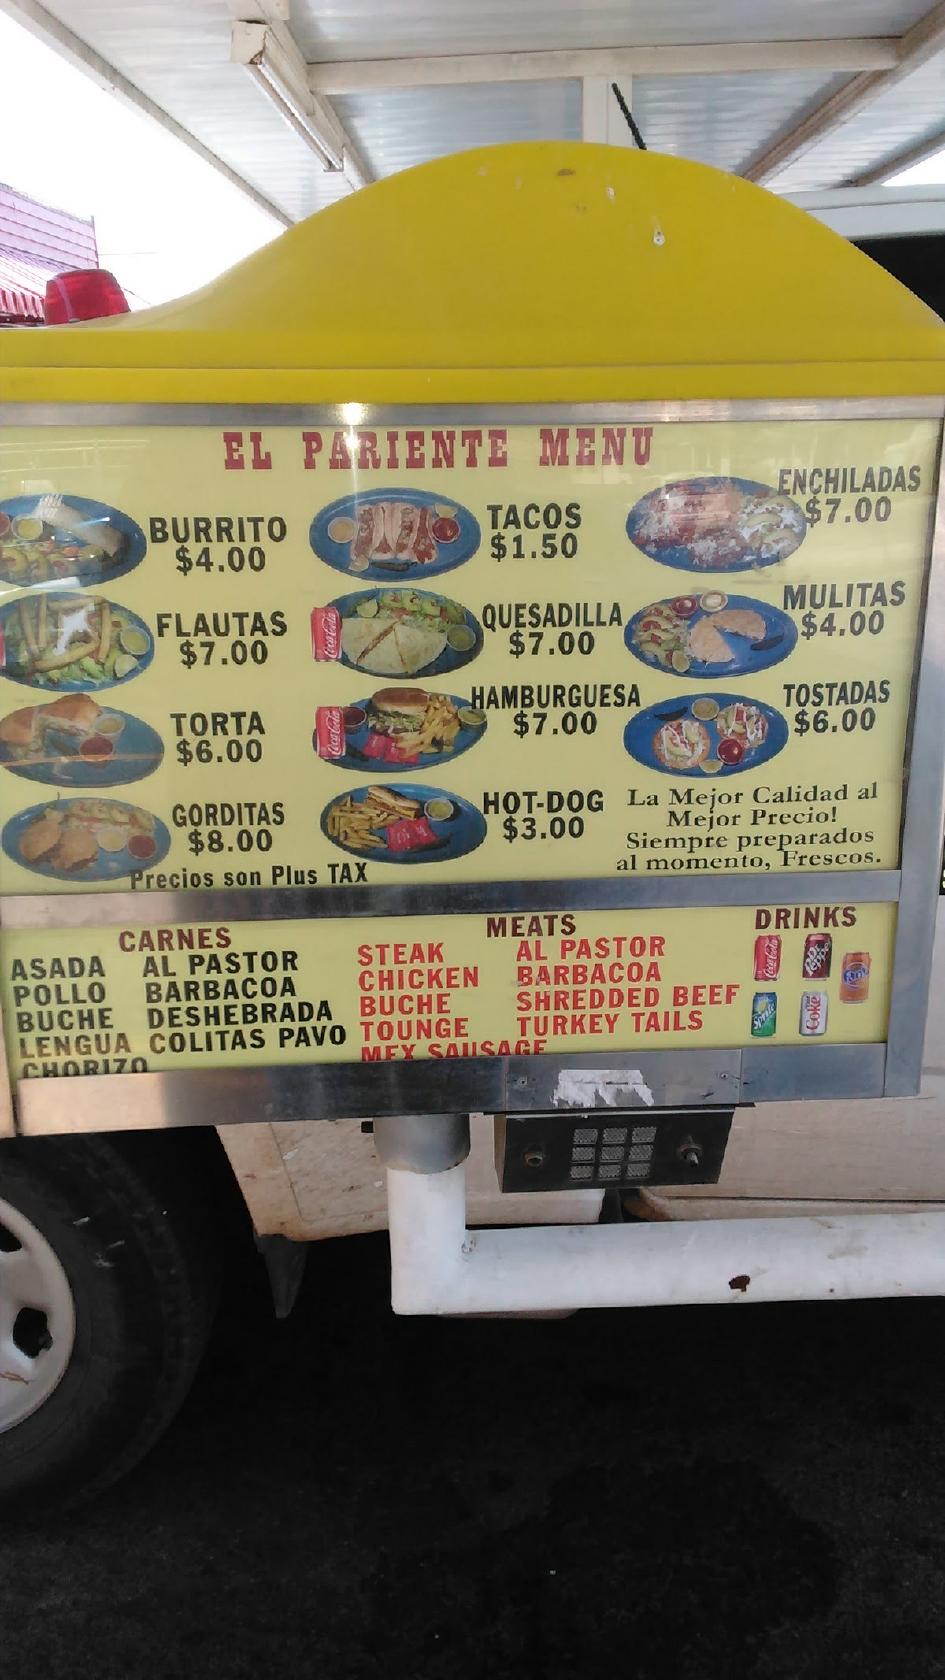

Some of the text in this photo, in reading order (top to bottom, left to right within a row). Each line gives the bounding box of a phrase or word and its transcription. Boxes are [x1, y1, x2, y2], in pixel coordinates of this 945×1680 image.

[223, 427, 653, 470] EL PARIENTE MENU
[777, 465, 921, 495] ENCHILADAS
[487, 503, 582, 530] TACOS
[805, 494, 892, 525] $7.00
[149, 516, 287, 543] BURRITO
[490, 532, 578, 561] $1.50
[175, 546, 266, 575] $4.00
[783, 580, 906, 610] MULITAS
[156, 610, 288, 637] FLAUTAS
[482, 602, 622, 629] QUESADILLA
[801, 609, 884, 640] $4.00
[179, 639, 269, 669] $7.00
[509, 630, 595, 656] $7.00
[471, 683, 641, 709] HAMBURGUESA
[783, 680, 891, 708] TOSTADAS
[170, 711, 266, 737] TORTA
[513, 710, 597, 737] $7.00
[794, 706, 876, 735] $6.00
[176, 739, 263, 767] $6.00
[483, 790, 604, 815] HOT-DOG
[627, 782, 878, 810] La Mejor Calidad al
[172, 802, 285, 827] GORDITAS
[667, 806, 837, 833] Mejor Precio!
[188, 828, 273, 856] $8.00
[503, 816, 584, 843] $3.00
[626, 827, 875, 854] Siempre preparados
[616, 849, 882, 871] al momento, Frescos.
[130, 863, 368, 890] Precios son Plus TAX
[486, 914, 577, 938] MEATS
[755, 906, 857, 930] DRINKS
[119, 927, 231, 953] CARNES
[516, 935, 666, 962] AL PASTOR
[143, 950, 299, 977] AL PASTOR
[357, 942, 445, 966] STEAK
[11, 956, 106, 981] ASADA
[358, 966, 478, 992] CHICKEN
[517, 961, 662, 987] BARBACOA
[13, 981, 106, 1007] POLLO
[145, 976, 297, 1003] BARBACOA
[516, 984, 740, 1012] SHREDDED BEEF
[148, 999, 334, 1030] DESHEBRADA
[359, 993, 451, 1018] BUCHE
[806, 996, 821, 1031] Coke
[17, 1007, 114, 1033] BUCHE
[360, 1016, 469, 1041] TOUNGE
[516, 1009, 704, 1037] TURKEY TAILS
[19, 1032, 132, 1059] LENGUA
[149, 1024, 347, 1055] COLITAS PAVO
[22, 1056, 148, 1079] CHORIZO
